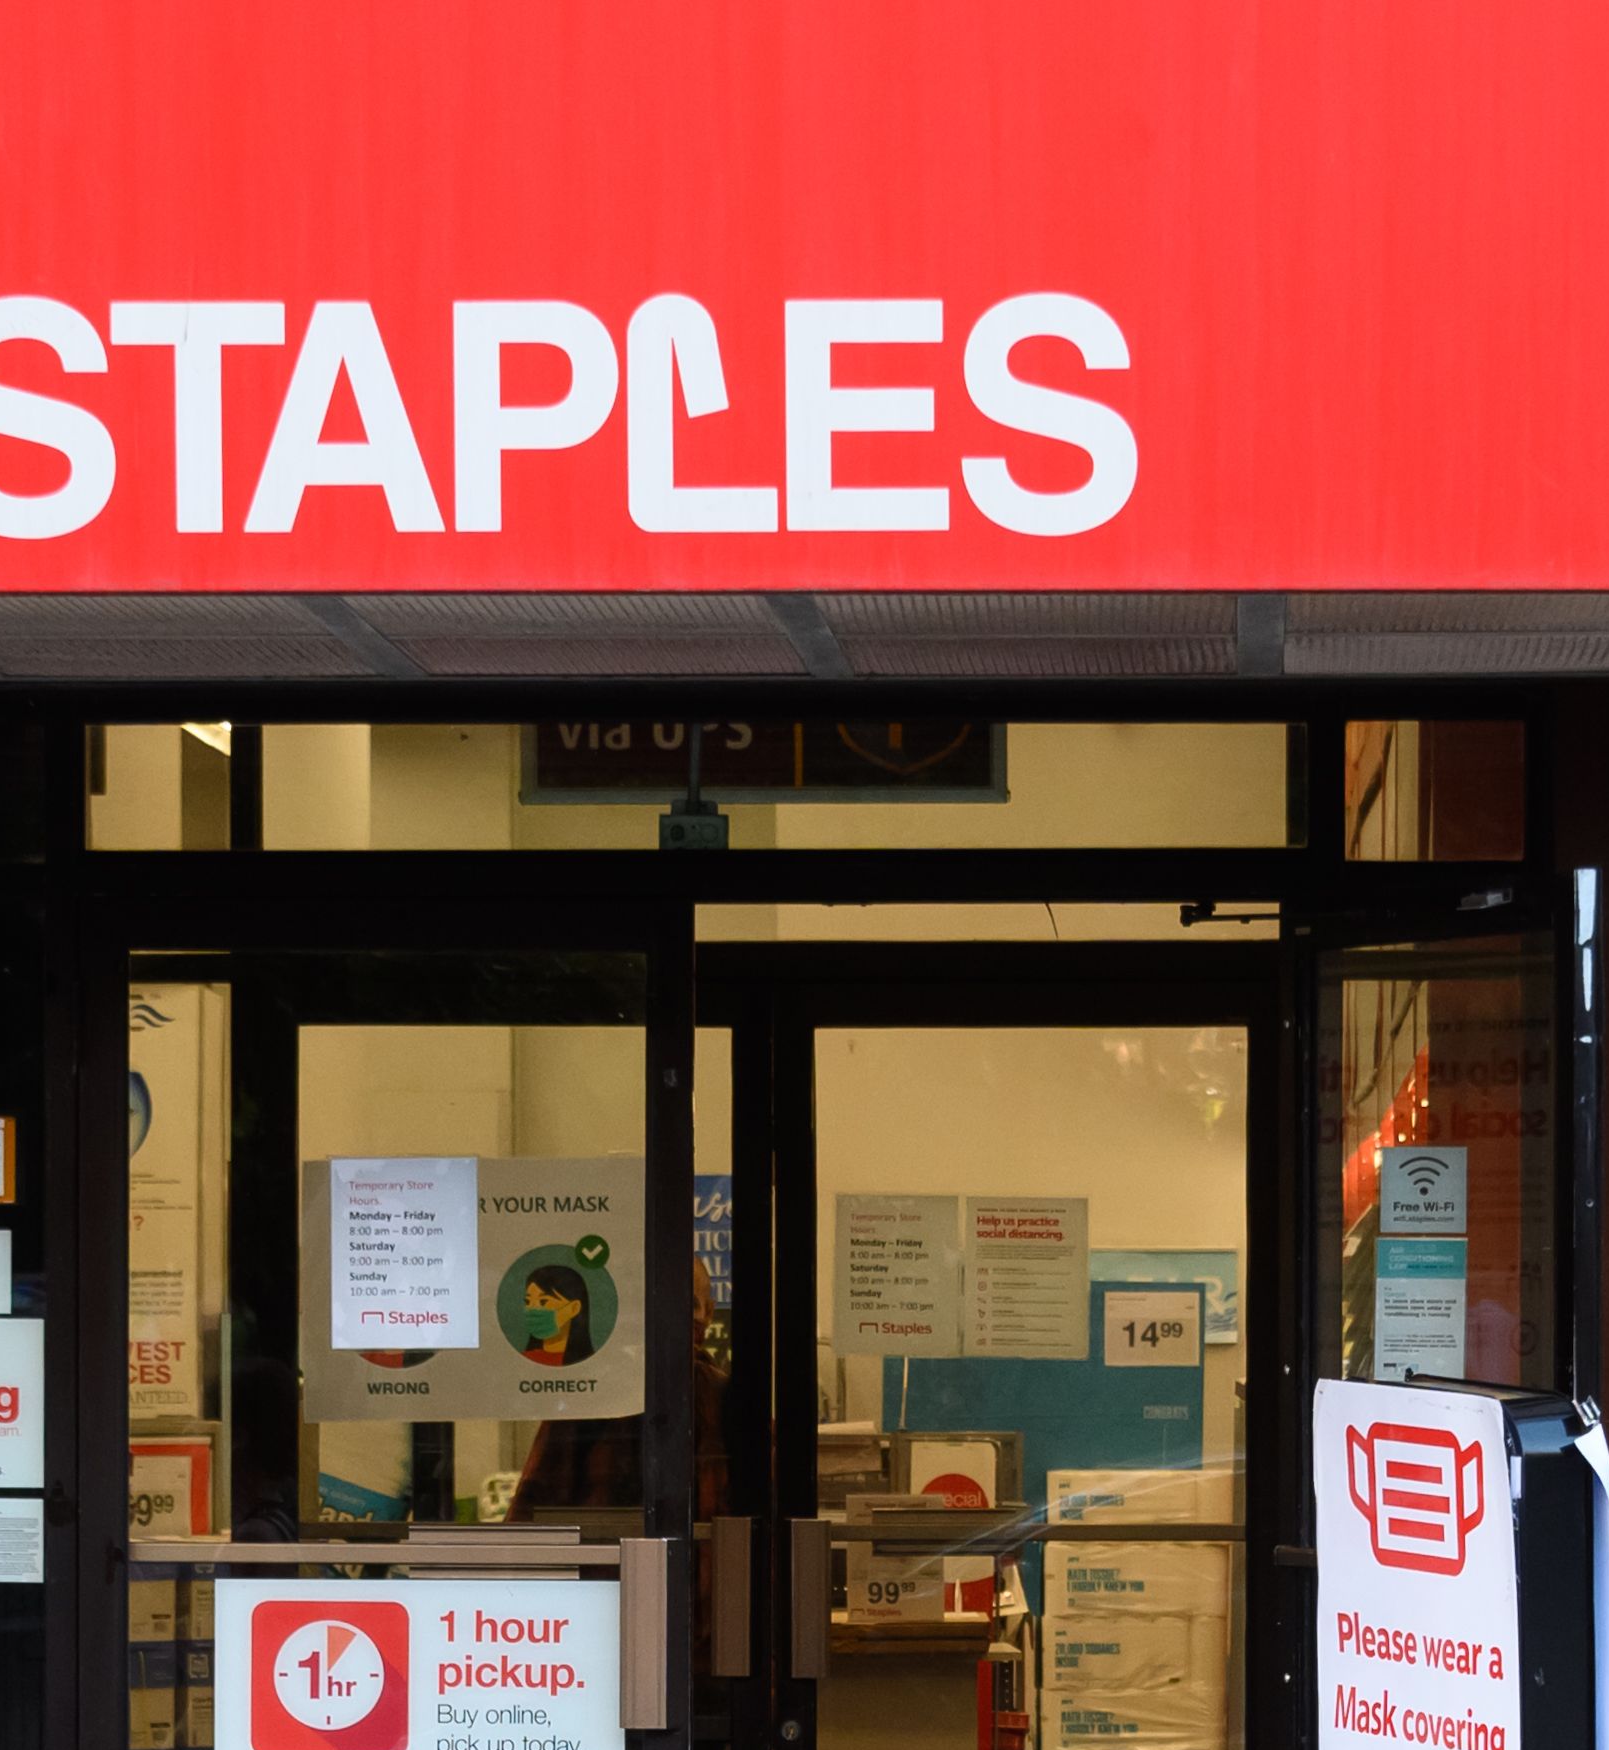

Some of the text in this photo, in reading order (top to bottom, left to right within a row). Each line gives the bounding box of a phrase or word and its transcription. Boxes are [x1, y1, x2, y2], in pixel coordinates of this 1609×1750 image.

[349, 1180, 434, 1192] Temporary Store
[492, 1196, 548, 1214] YOUR
[553, 1196, 610, 1213] MASK
[1393, 1202, 1455, 1212] Free Wi-Fi
[349, 1211, 436, 1223] Monday Friday
[977, 1216, 1060, 1231] Help us practice
[349, 1226, 372, 1236] 8:00
[401, 1226, 424, 1236] 8:00
[426, 1228, 443, 1238] pm
[977, 1229, 1007, 1239] social
[349, 1242, 396, 1253] Saturday
[349, 1256, 372, 1266] 9:00
[401, 1256, 424, 1266] 8:00
[426, 1258, 443, 1268] pm
[349, 1272, 388, 1283] Sunday
[349, 1286, 379, 1297] 10:00
[408, 1286, 431, 1296] 7:00
[433, 1288, 450, 1298] pm
[388, 1311, 449, 1327] Staples
[881, 1322, 933, 1337] Staples
[367, 1379, 598, 1396] WRONG CORRECT
[439, 1609, 570, 1643] 1 hour
[1337, 1611, 1504, 1680] Please wear a
[438, 1655, 586, 1696] pickup.
[437, 1704, 552, 1728] Buy online,
[1334, 1684, 1397, 1738] Mask
